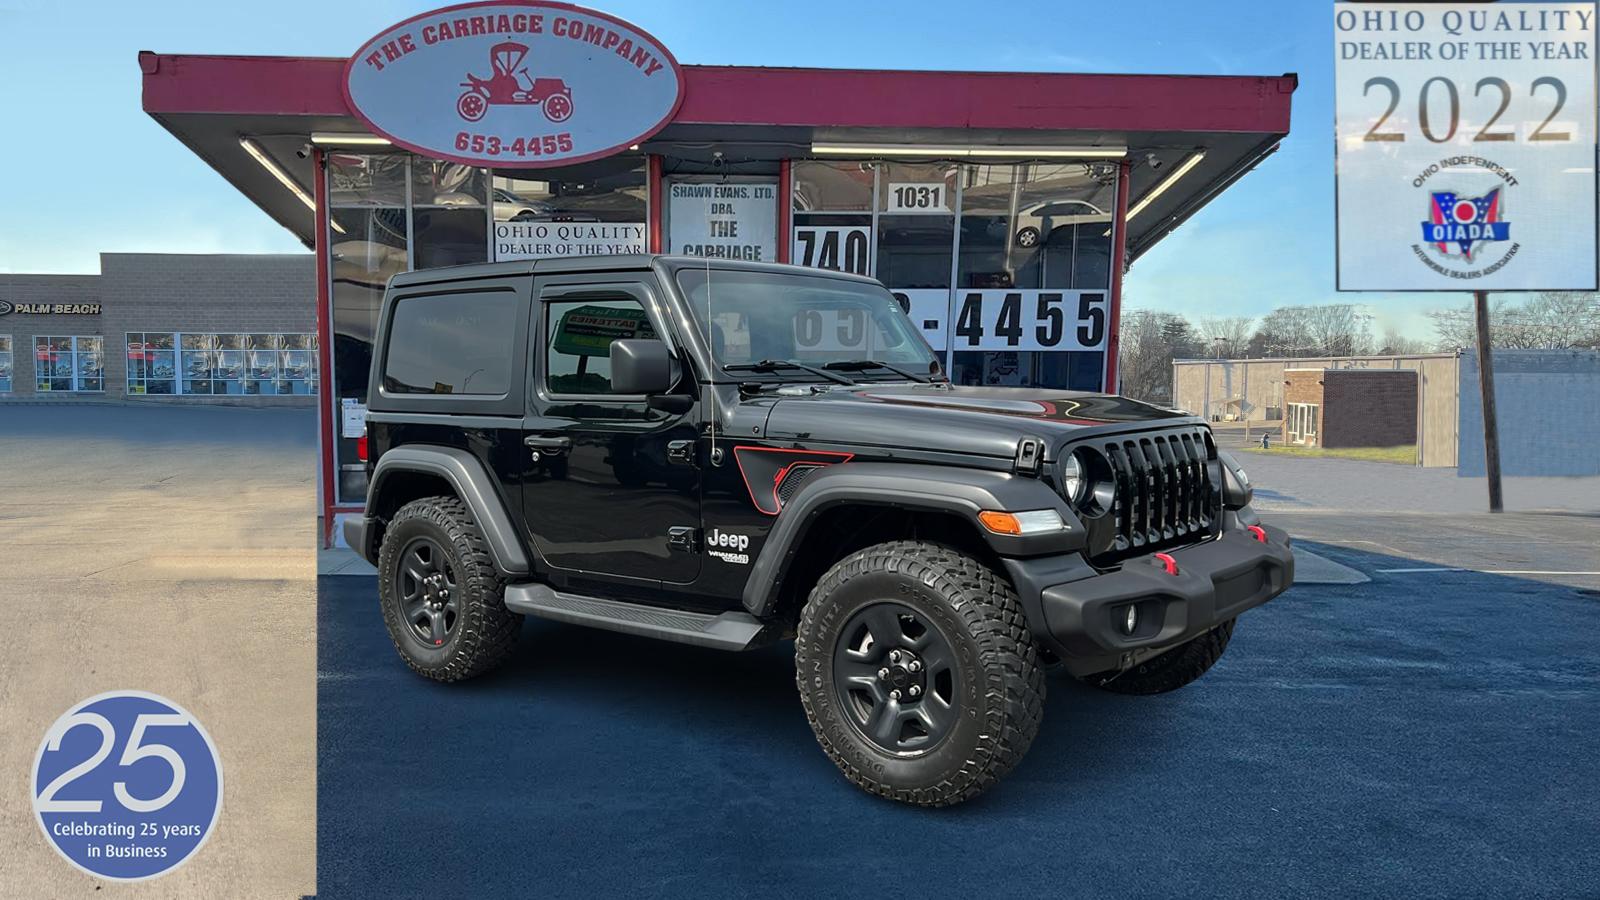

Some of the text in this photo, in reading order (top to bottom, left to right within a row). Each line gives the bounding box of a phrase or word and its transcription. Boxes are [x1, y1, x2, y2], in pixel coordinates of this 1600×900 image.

[1336, 10, 1593, 35] OHIO QUALITY
[366, 14, 664, 77] THE CARRIAGE COMPANY
[1340, 41, 1589, 60] DEALER OF THE YEAR
[1363, 76, 1571, 143] 2022
[455, 132, 573, 156] 653-4455
[1412, 155, 1519, 188] OHIO INDEPENDENT
[672, 186, 712, 199] SHAWN
[754, 187, 775, 199] LTD.
[895, 186, 941, 208] 1031
[711, 203, 736, 215] DBA.
[497, 225, 645, 241] OHIO QUALITY
[710, 220, 738, 238] THE
[1432, 224, 1495, 241] OIADA
[500, 243, 642, 255] DEALER OF THE YEAR
[683, 244, 762, 261] CARRIAGE
[797, 230, 868, 275] 740
[1411, 242, 1521, 280] AUTOMOBILE DEALERS ASSOCIATION
[14, 303, 101, 314] PALM BEACH
[708, 528, 749, 551] Jeep
